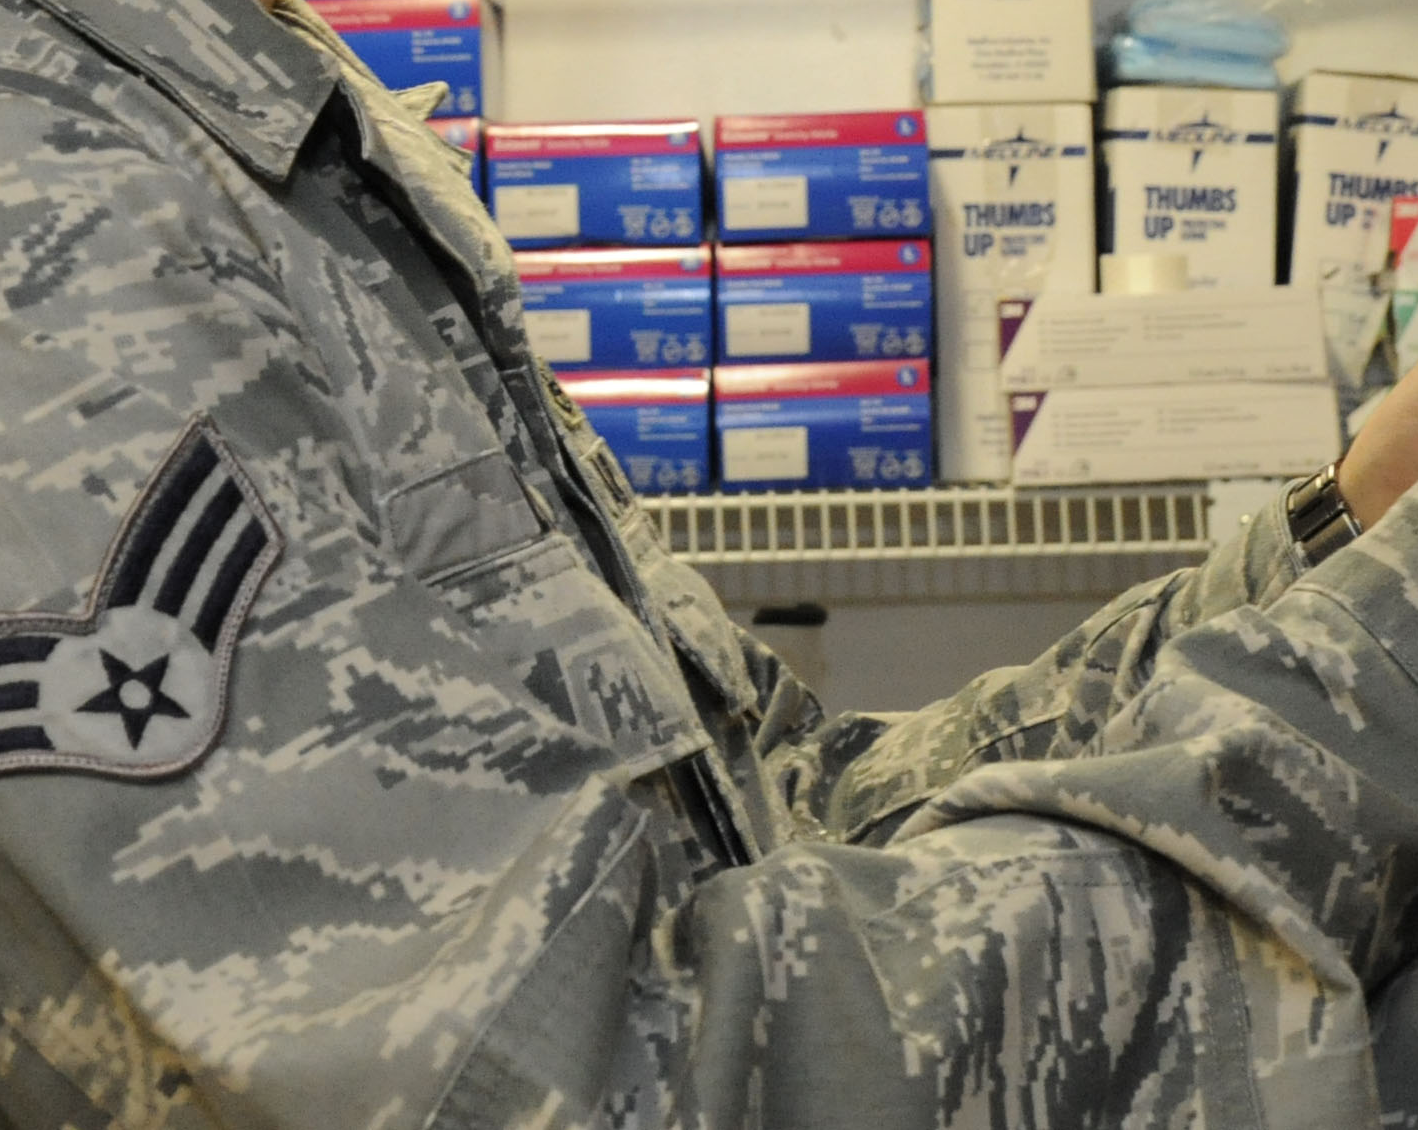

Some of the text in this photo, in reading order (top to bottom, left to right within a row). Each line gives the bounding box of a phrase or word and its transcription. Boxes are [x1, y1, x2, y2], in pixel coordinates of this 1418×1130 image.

[1144, 186, 1236, 212] THUMBS
[963, 202, 1055, 227] THUMBS
[1326, 203, 1356, 227] UP
[1144, 216, 1174, 240] UP
[964, 233, 994, 257] UP
